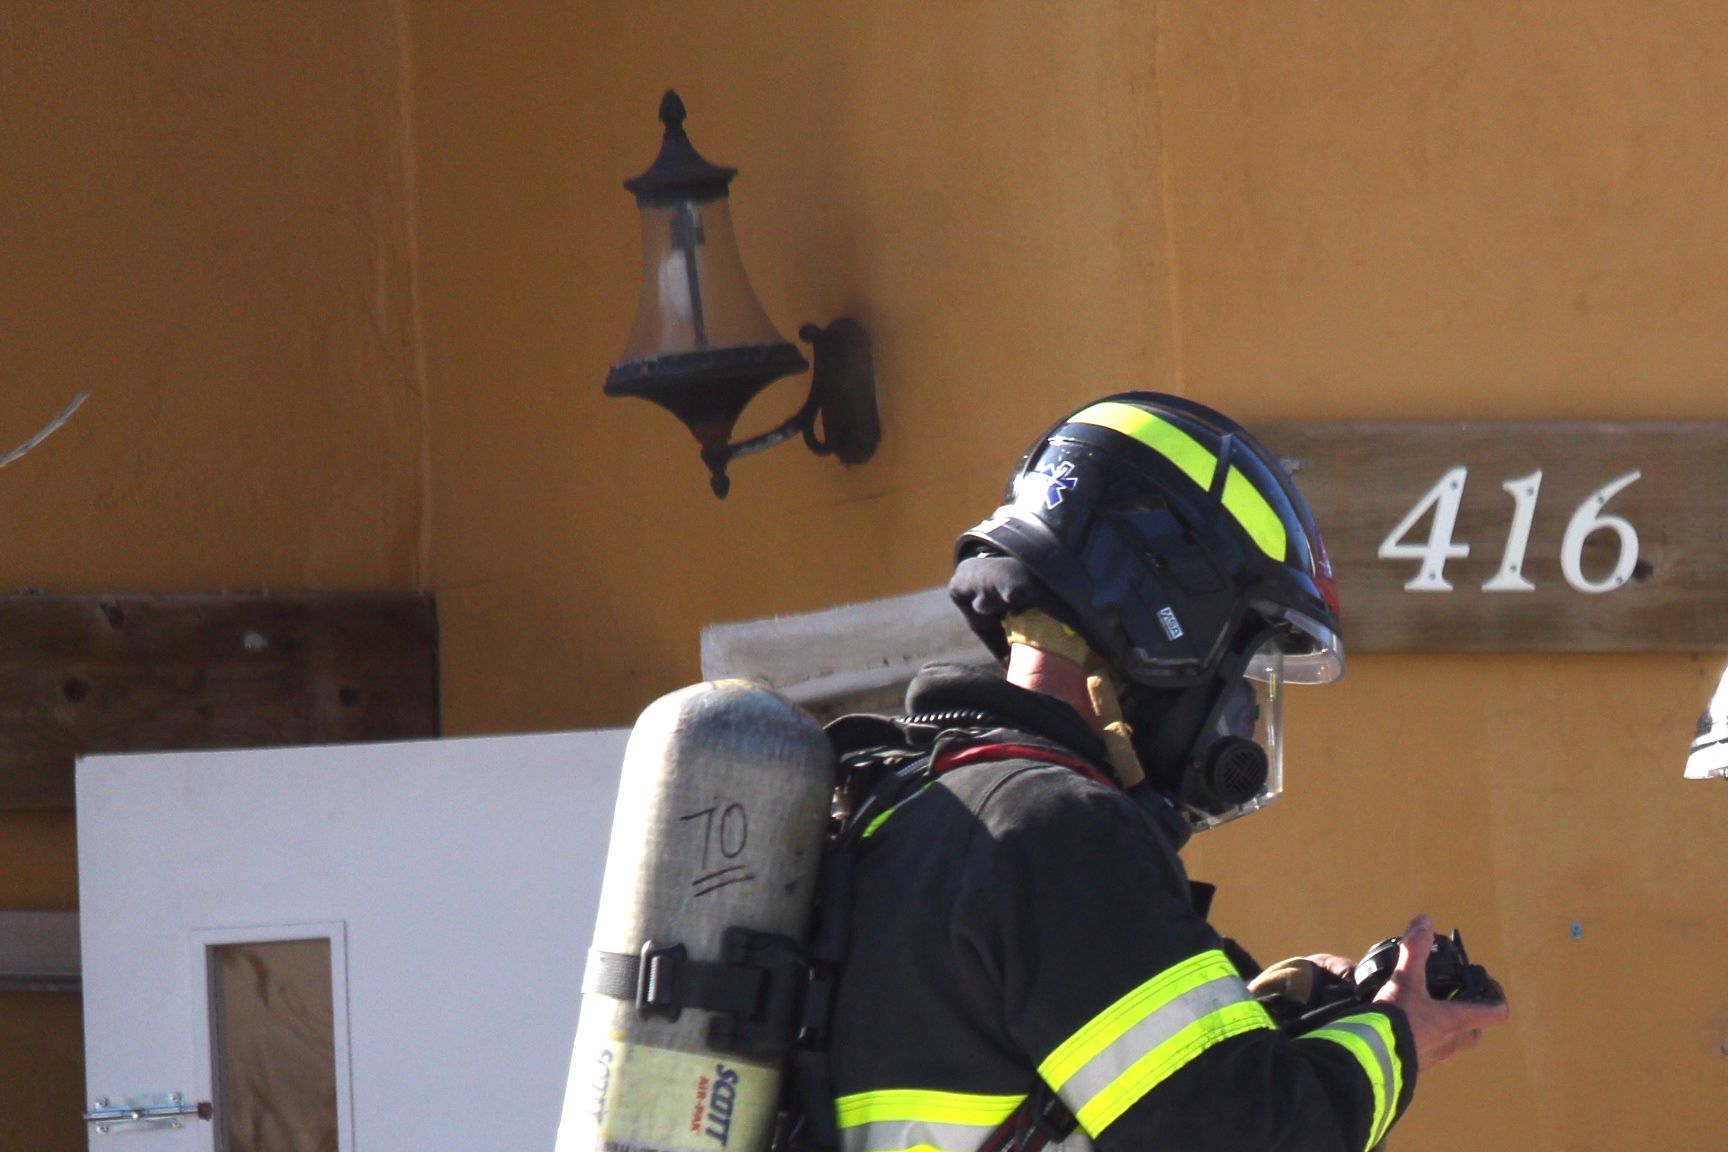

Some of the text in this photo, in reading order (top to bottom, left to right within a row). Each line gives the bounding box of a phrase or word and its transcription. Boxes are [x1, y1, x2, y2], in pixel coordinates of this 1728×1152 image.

[1378, 465, 1641, 594] 416
[1160, 608, 1182, 638] MSA
[679, 803, 748, 870] 70
[691, 1076, 710, 1132] AIR-PAK
[706, 1063, 738, 1147] SCOTT
